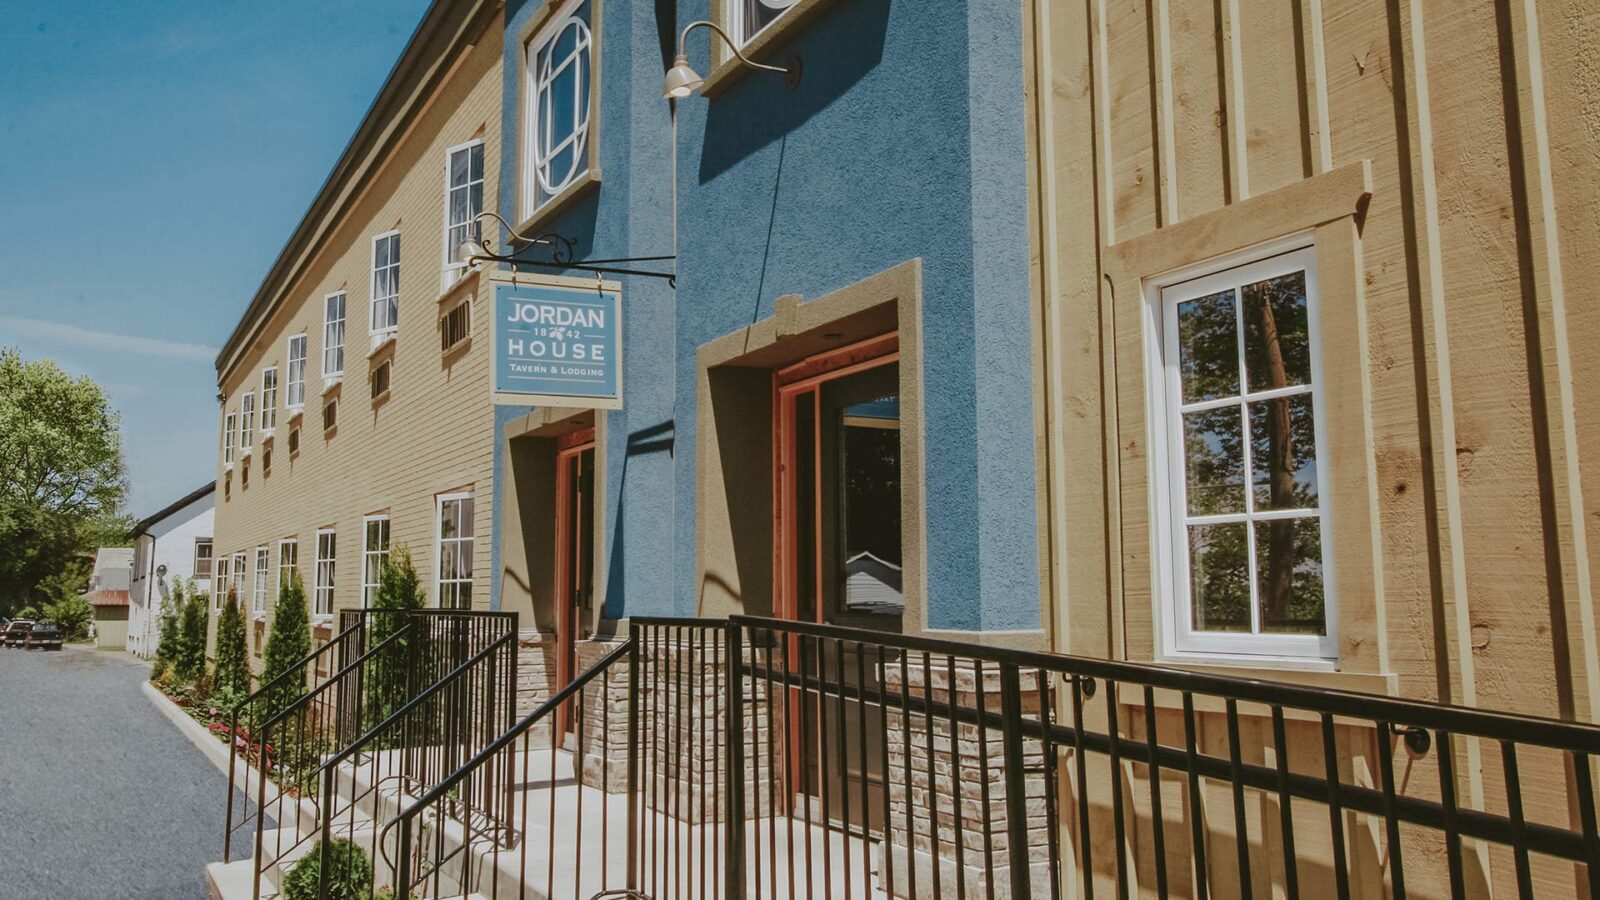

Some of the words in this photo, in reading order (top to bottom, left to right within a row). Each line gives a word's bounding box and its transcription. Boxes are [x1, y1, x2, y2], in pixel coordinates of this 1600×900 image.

[507, 303, 605, 329] JORDAN
[508, 338, 605, 361] HOUSE
[509, 363, 547, 373] TAVERN
[550, 366, 558, 374] &
[561, 366, 604, 377] LODGING
